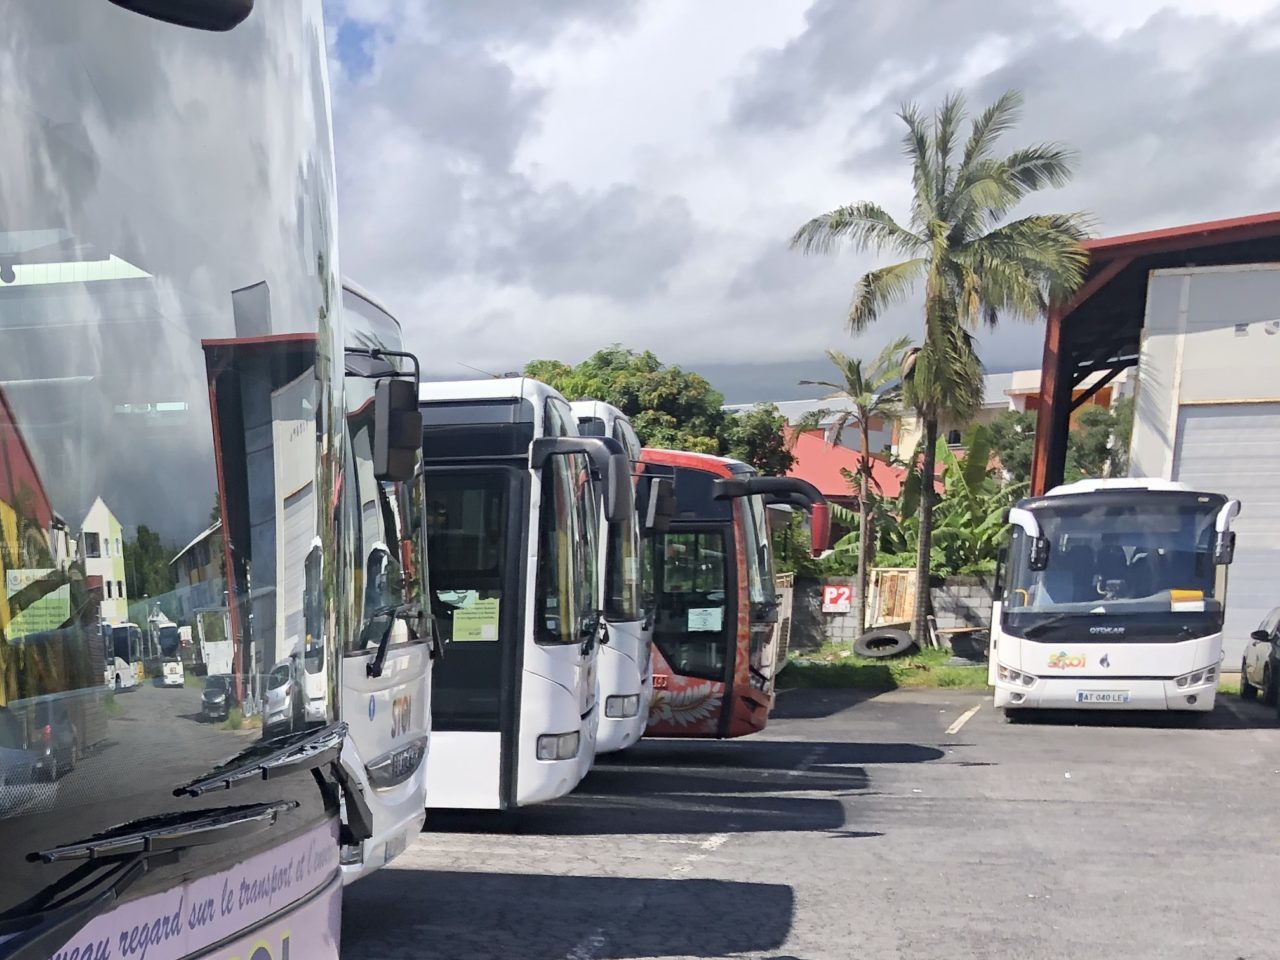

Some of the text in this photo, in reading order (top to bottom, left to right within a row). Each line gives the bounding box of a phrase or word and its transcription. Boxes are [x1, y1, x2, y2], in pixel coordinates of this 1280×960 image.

[824, 587, 850, 604] P2
[188, 898, 216, 929] sur
[221, 877, 234, 916] le
[239, 856, 294, 910] transport
